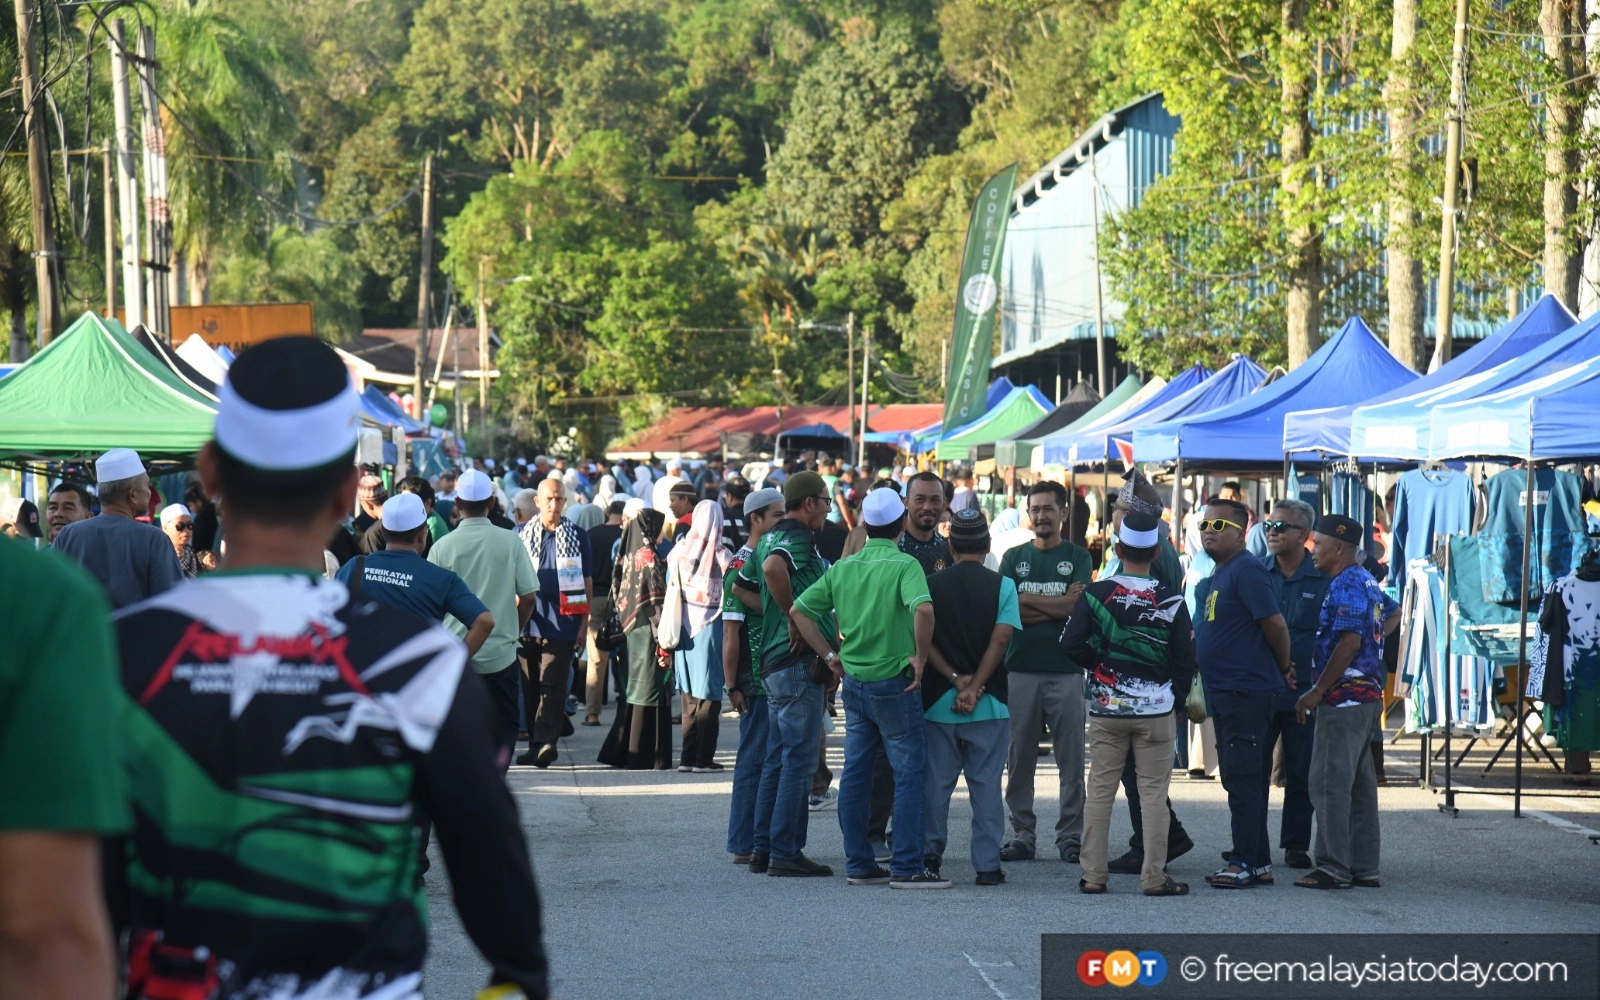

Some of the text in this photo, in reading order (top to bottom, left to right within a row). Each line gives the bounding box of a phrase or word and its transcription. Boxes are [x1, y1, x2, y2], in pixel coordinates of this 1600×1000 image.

[981, 188, 998, 271] COFFEE
[364, 567, 413, 581] PERIKATAN
[365, 574, 410, 587] NASIONAL
[1018, 581, 1067, 593] HIMPUNAN
